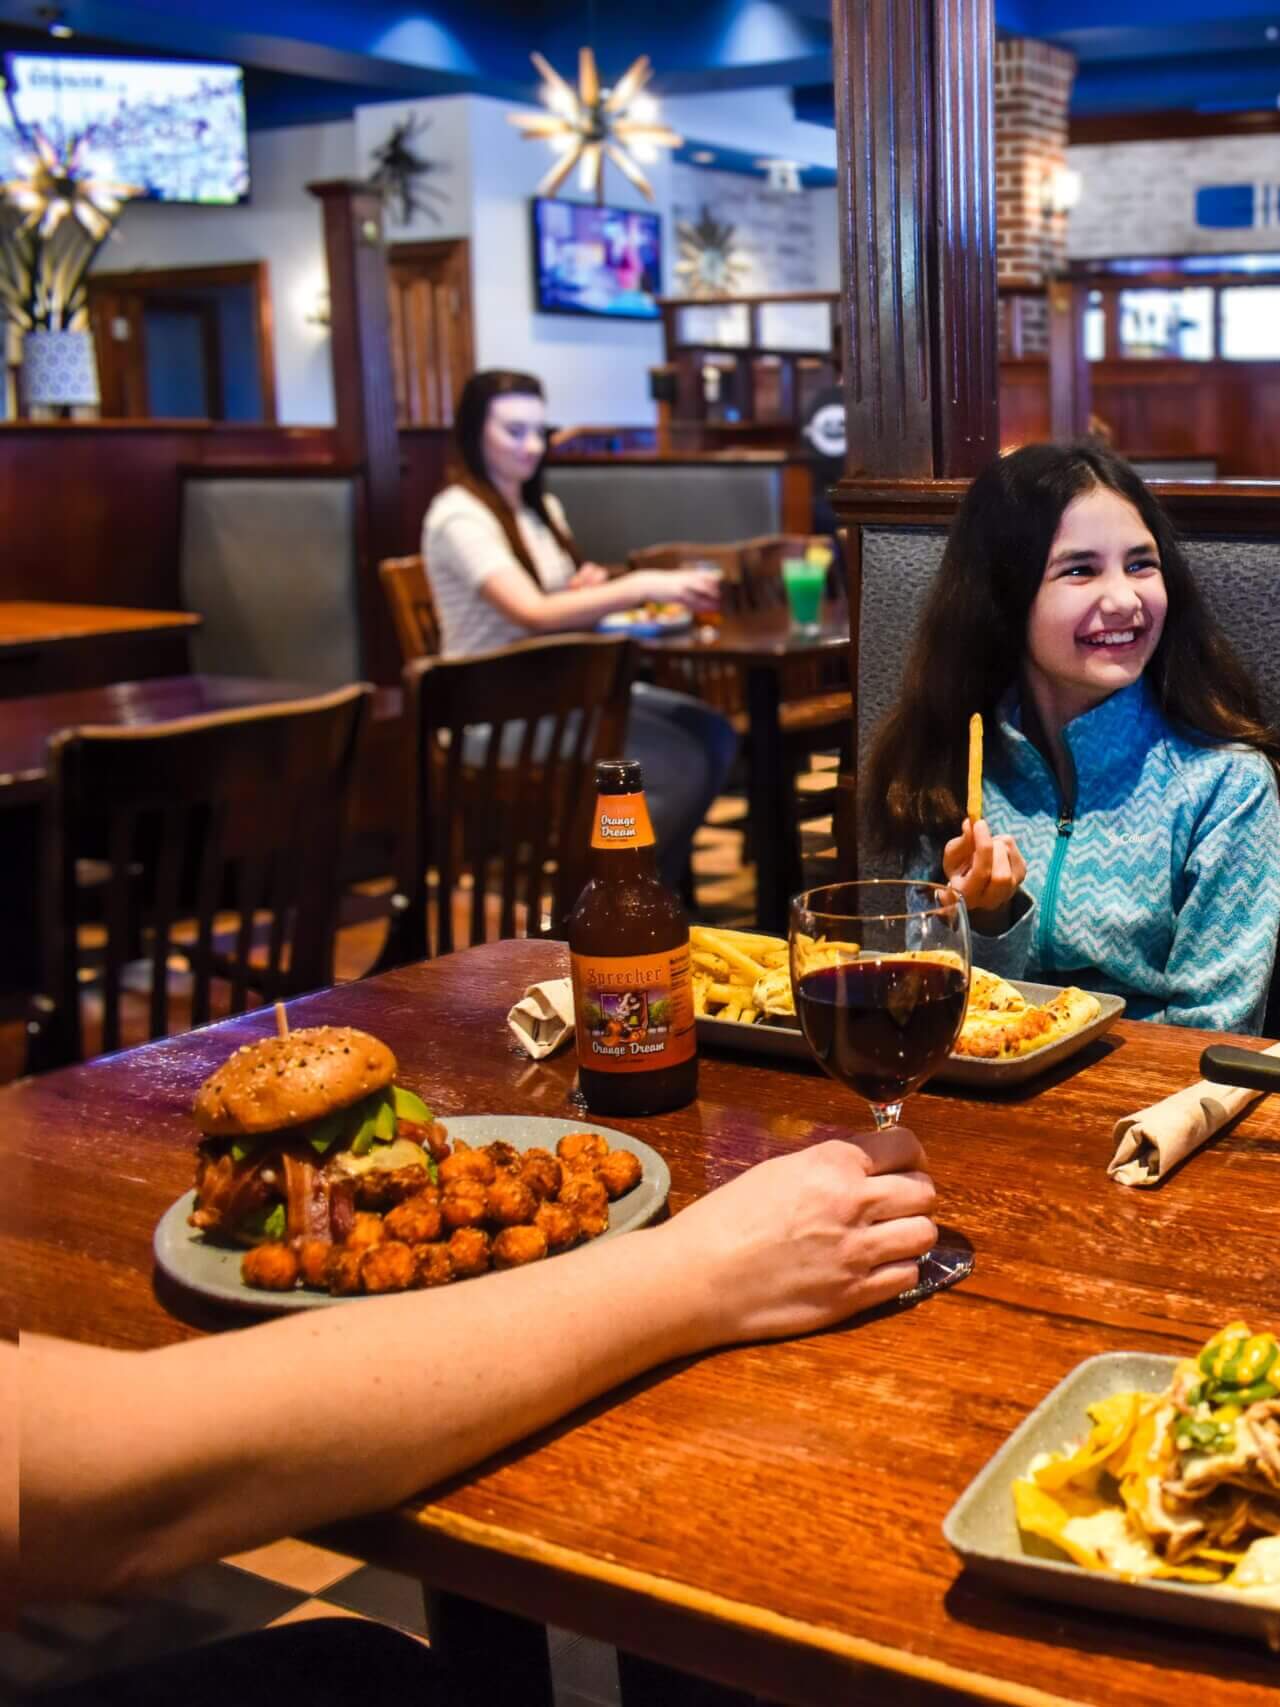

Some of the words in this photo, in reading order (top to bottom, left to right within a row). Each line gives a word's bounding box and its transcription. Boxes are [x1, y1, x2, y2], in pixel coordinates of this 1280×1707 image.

[601, 814, 635, 828] Orange
[601, 825, 636, 837] Dream
[586, 967, 663, 985] Sprecher
[592, 1041, 625, 1056] Orange
[629, 1042, 664, 1055] Dream
